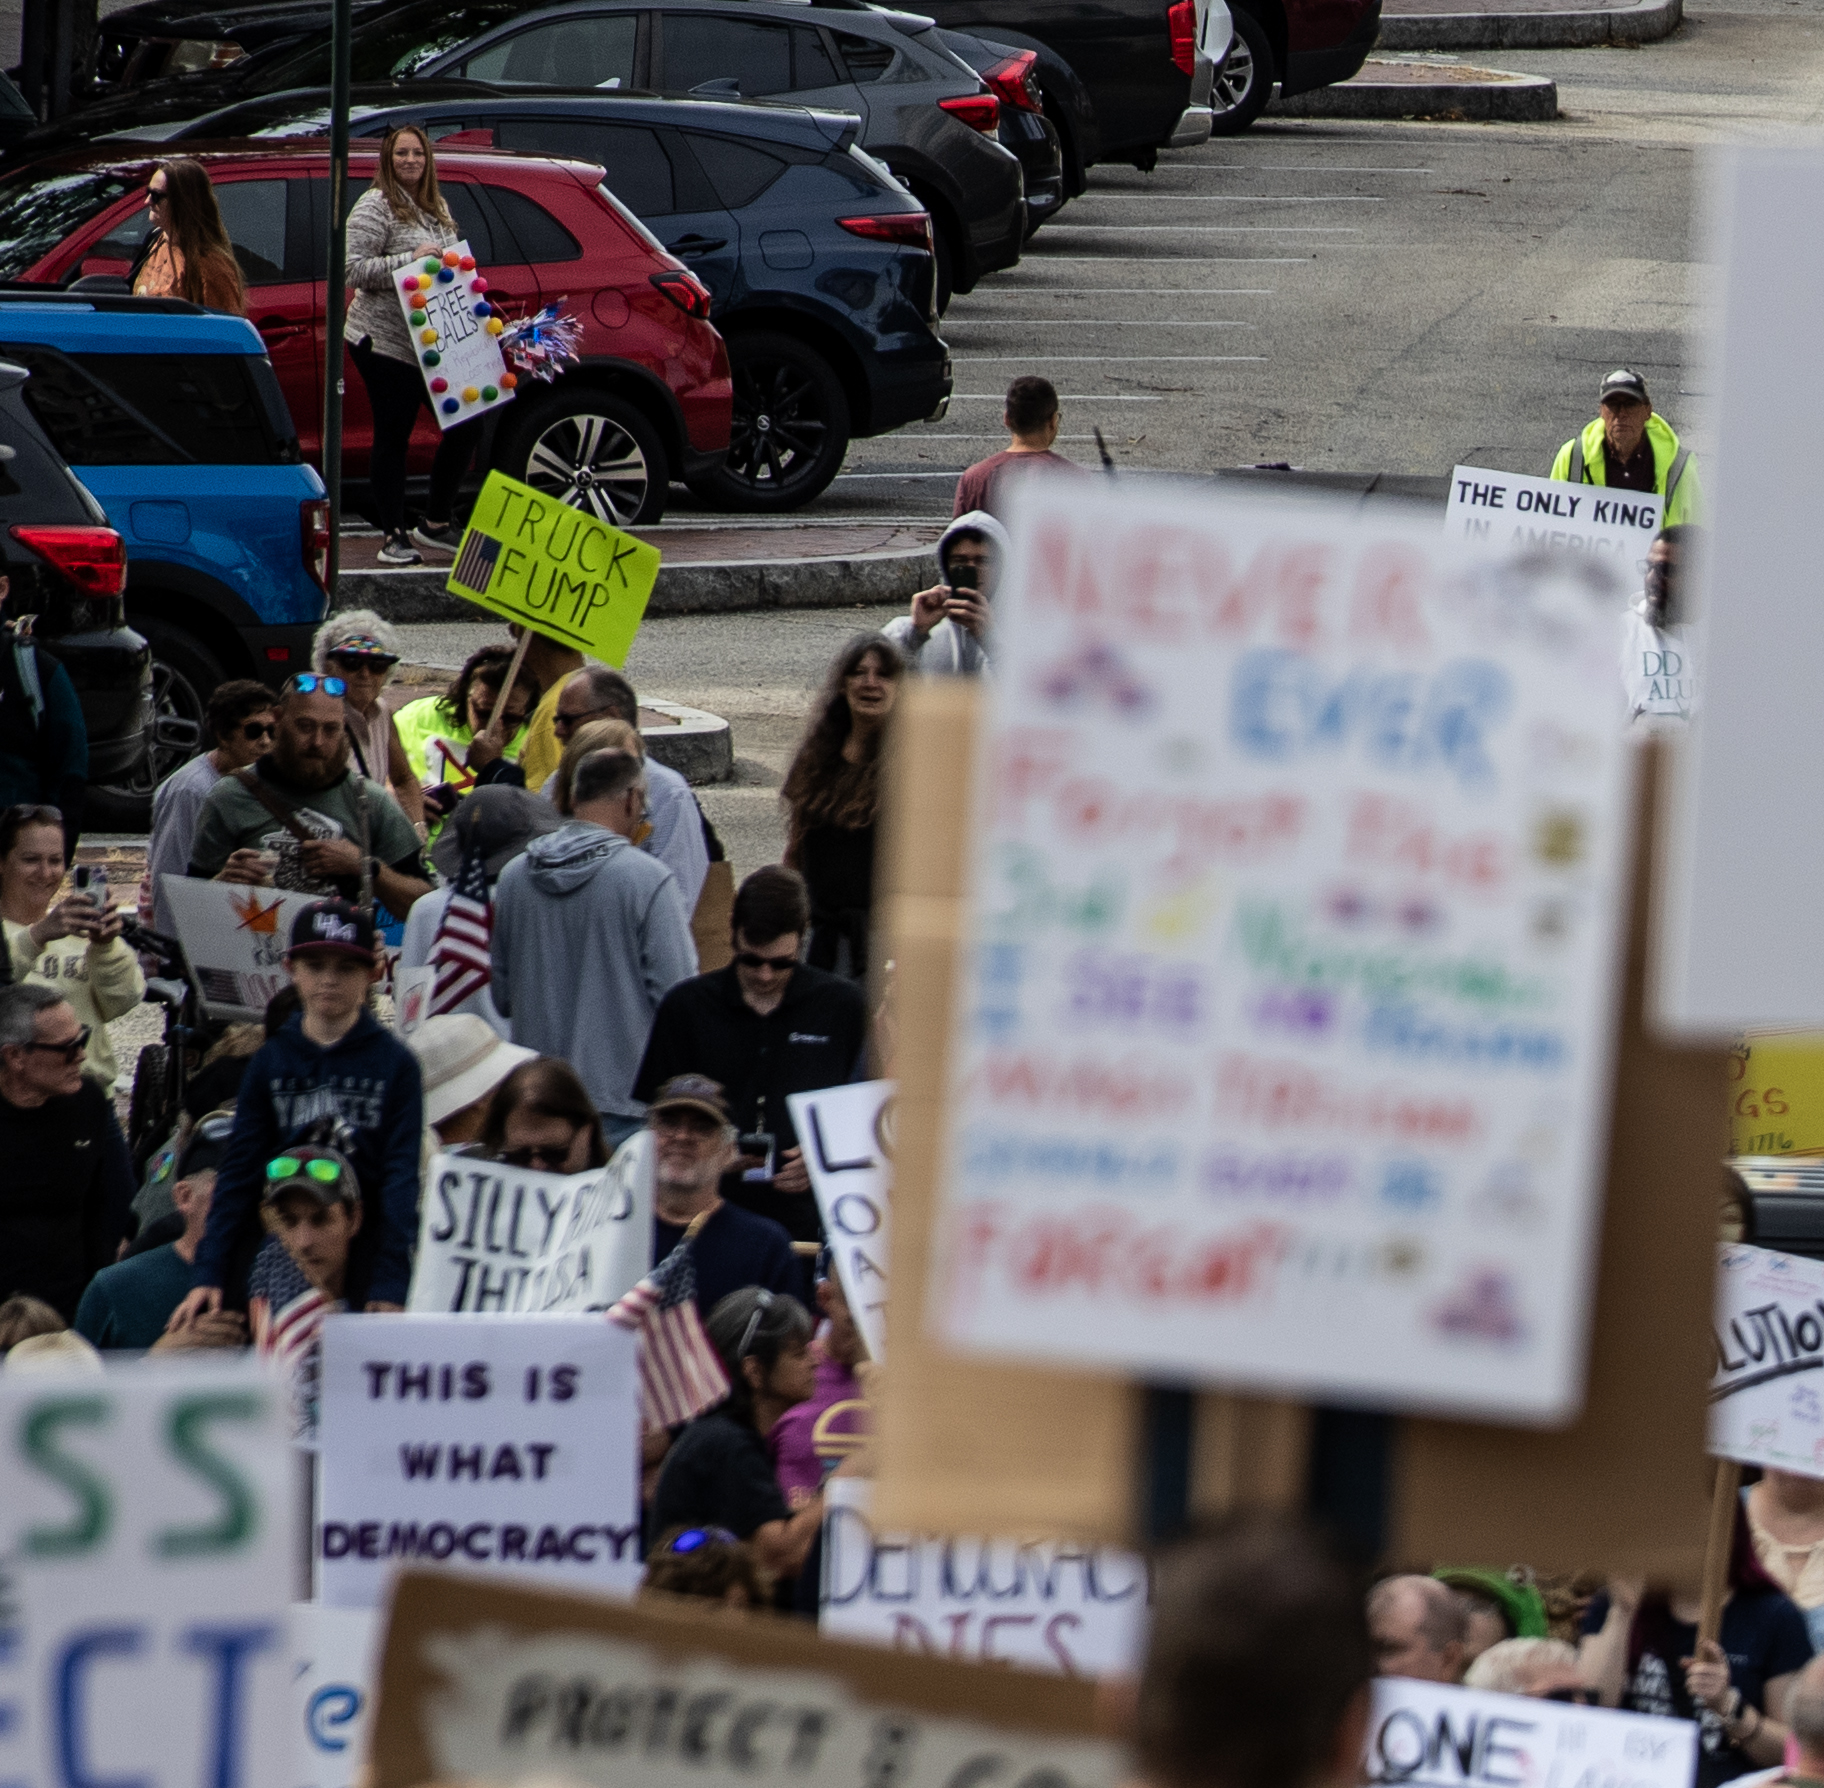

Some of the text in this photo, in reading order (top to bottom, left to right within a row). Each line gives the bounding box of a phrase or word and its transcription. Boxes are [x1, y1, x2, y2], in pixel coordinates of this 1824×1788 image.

[425, 284, 468, 327] FREE
[436, 311, 479, 353] BALLS
[1457, 480, 1656, 530] THE ONLY KING
[495, 485, 638, 589] TRUCK
[1464, 517, 1491, 542] IN
[496, 548, 611, 628] FUMP
[430, 1169, 568, 1258] SILLY
[362, 1359, 582, 1403] THIS IS
[399, 1442, 558, 1483] WHAT
[321, 1518, 641, 1564] DEMOCRACY
[501, 1670, 833, 1776] PROTECT
[1375, 1706, 1541, 1787] ONE
